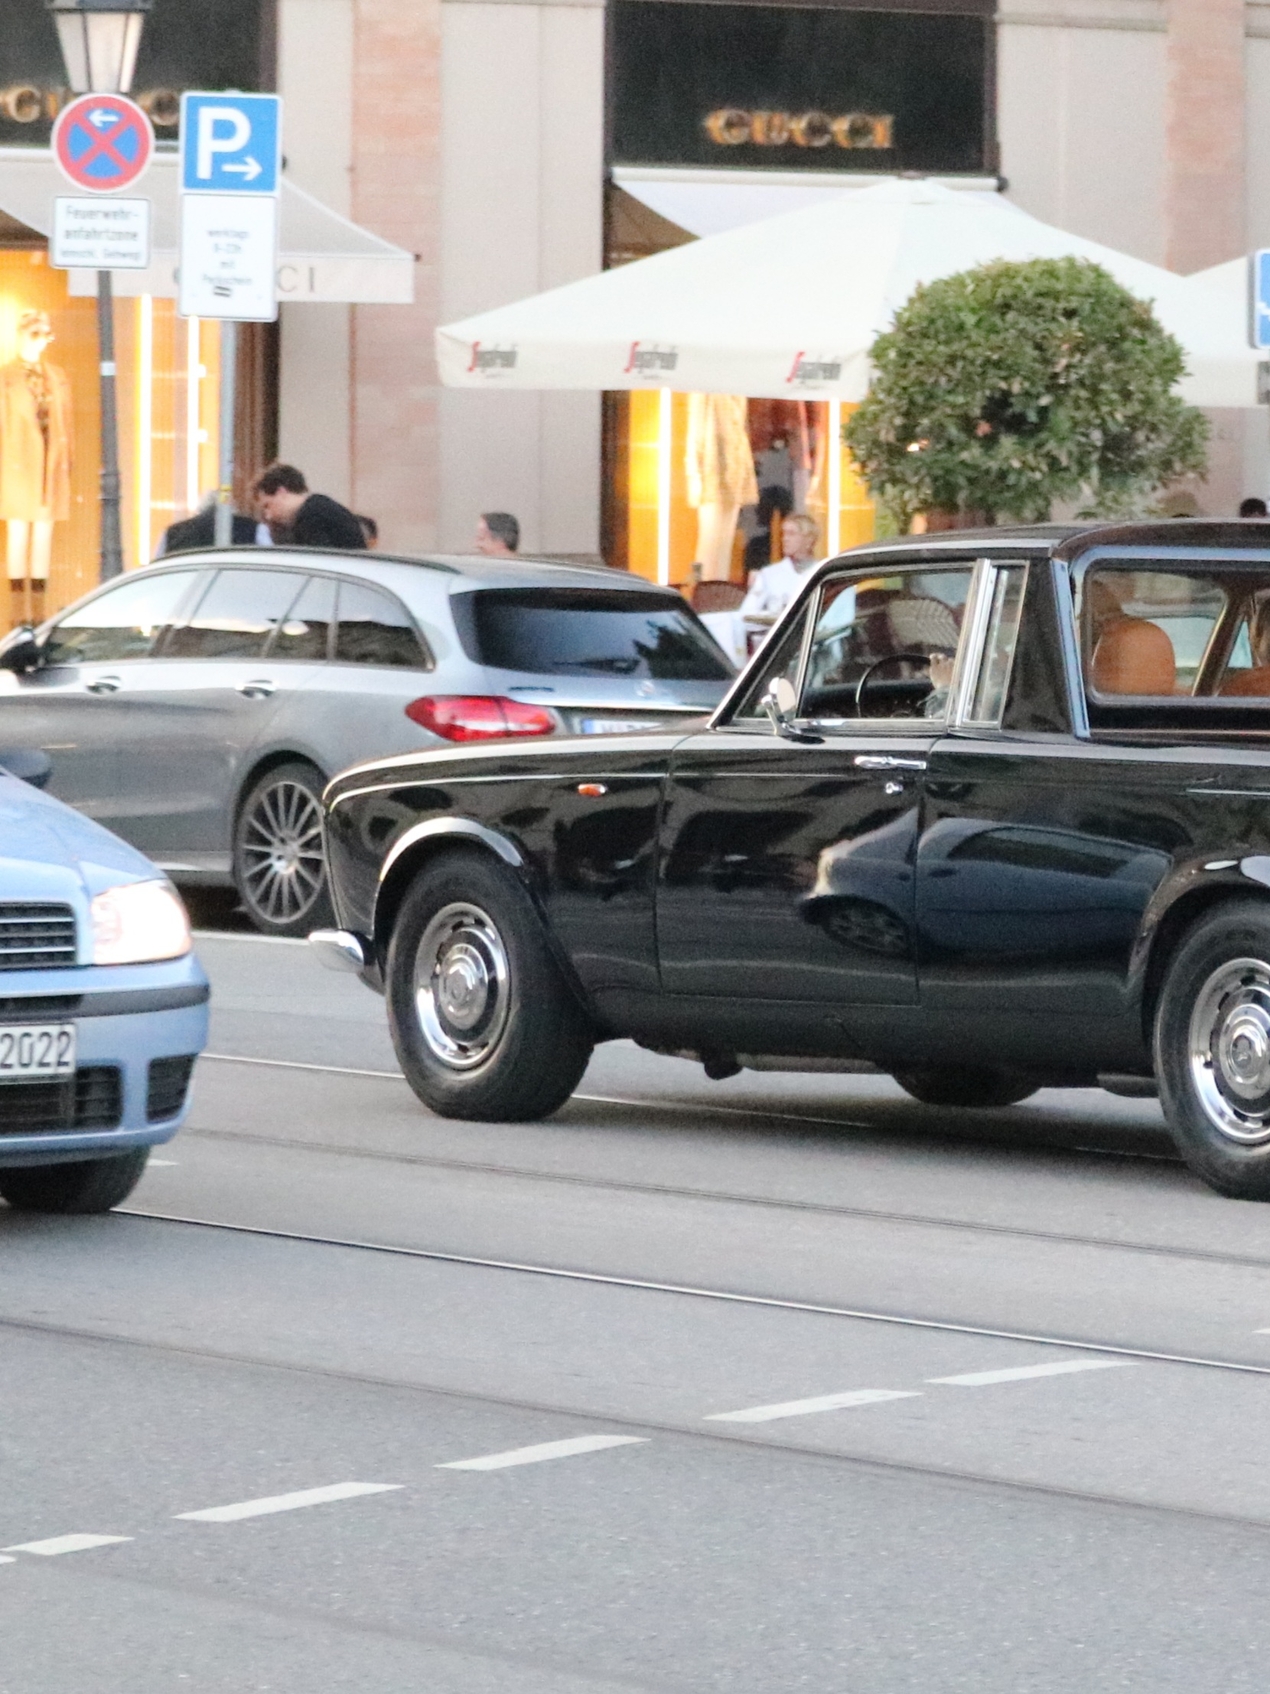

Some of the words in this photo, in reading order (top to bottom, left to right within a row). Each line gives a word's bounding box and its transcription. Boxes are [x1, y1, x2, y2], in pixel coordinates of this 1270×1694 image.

[197, 106, 251, 180] P
[704, 108, 893, 149] GUCCI
[0, 1031, 71, 1069] 2022
